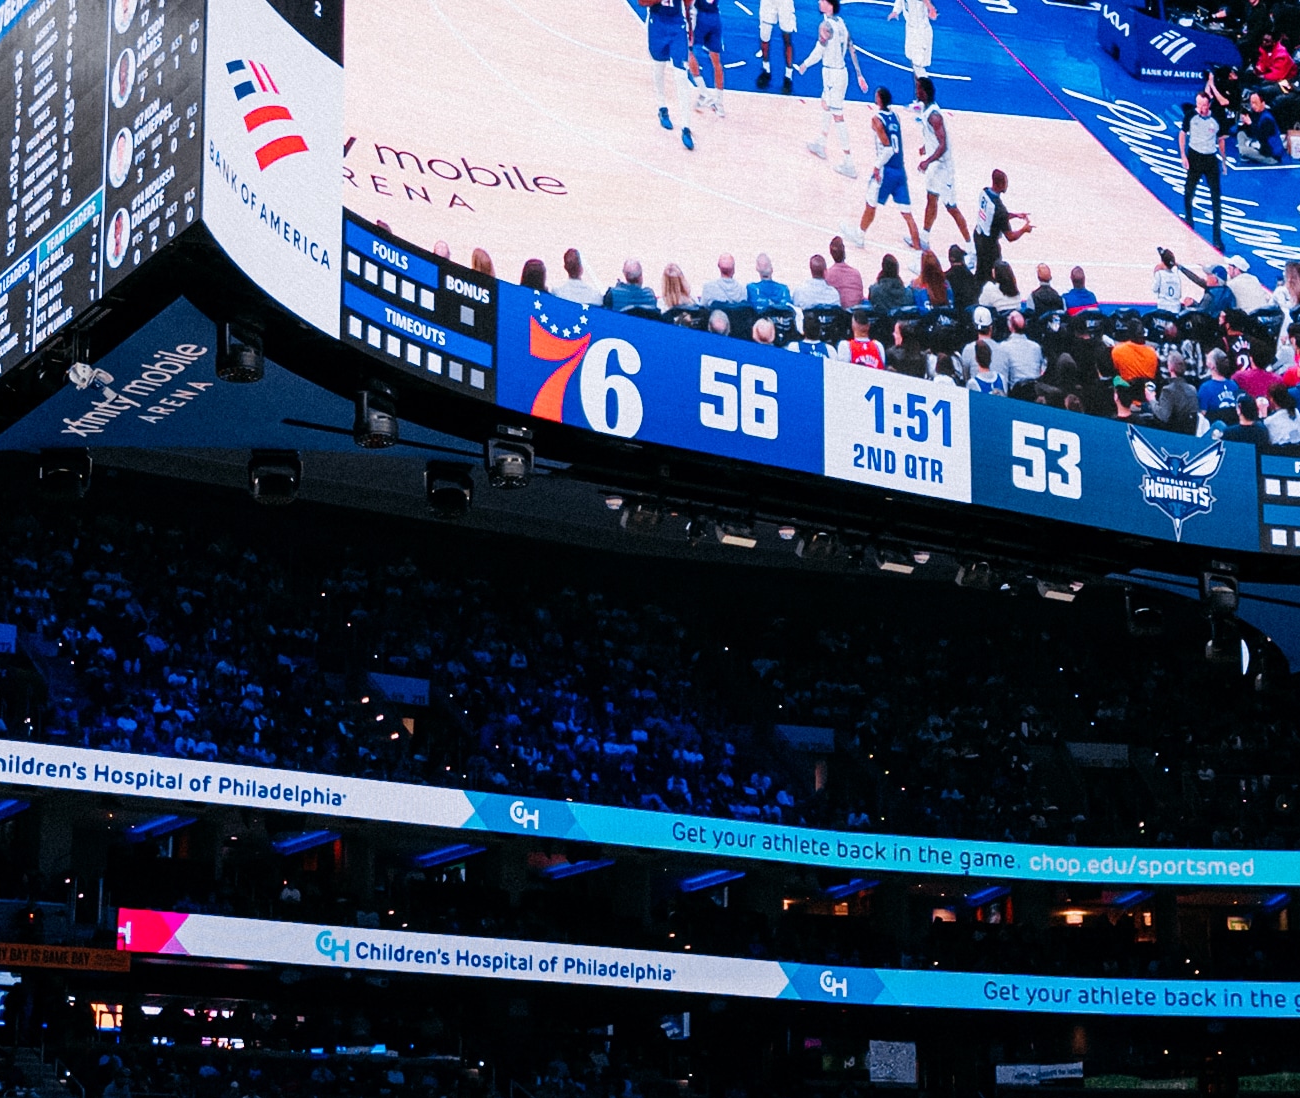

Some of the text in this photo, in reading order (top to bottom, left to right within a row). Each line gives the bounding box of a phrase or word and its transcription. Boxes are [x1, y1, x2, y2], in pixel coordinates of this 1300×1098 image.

[374, 142, 568, 196] mobile
[46, 202, 97, 254] TEAM LEADERS
[210, 139, 331, 271] BANK OF AMERICA
[372, 240, 489, 303] FOULS BONUS
[384, 307, 446, 347] TIMEOUTS
[61, 343, 209, 438] xfinity mobile
[529, 315, 643, 436] 76
[700, 354, 779, 440] 56
[138, 382, 214, 424] ARENA
[864, 384, 953, 448] 1:51
[852, 442, 944, 484] 2ND QTR
[1012, 420, 1083, 500] 53
[1144, 477, 1210, 508] HORNETS
[94, 763, 183, 794] Hospital
[190, 774, 212, 795] of
[218, 777, 343, 808] Philadelphia
[672, 821, 1255, 877] Get your athlete back in the game. chop.edu/sportsmed
[355, 940, 673, 983] Children's Hospital of Philadelphia
[983, 980, 1020, 1002] Get
[1026, 984, 1071, 1008] your
[1077, 984, 1157, 1008] athlete
[1164, 986, 1216, 1009] back
[1223, 988, 1242, 1009] in
[1250, 988, 1287, 1010] the
